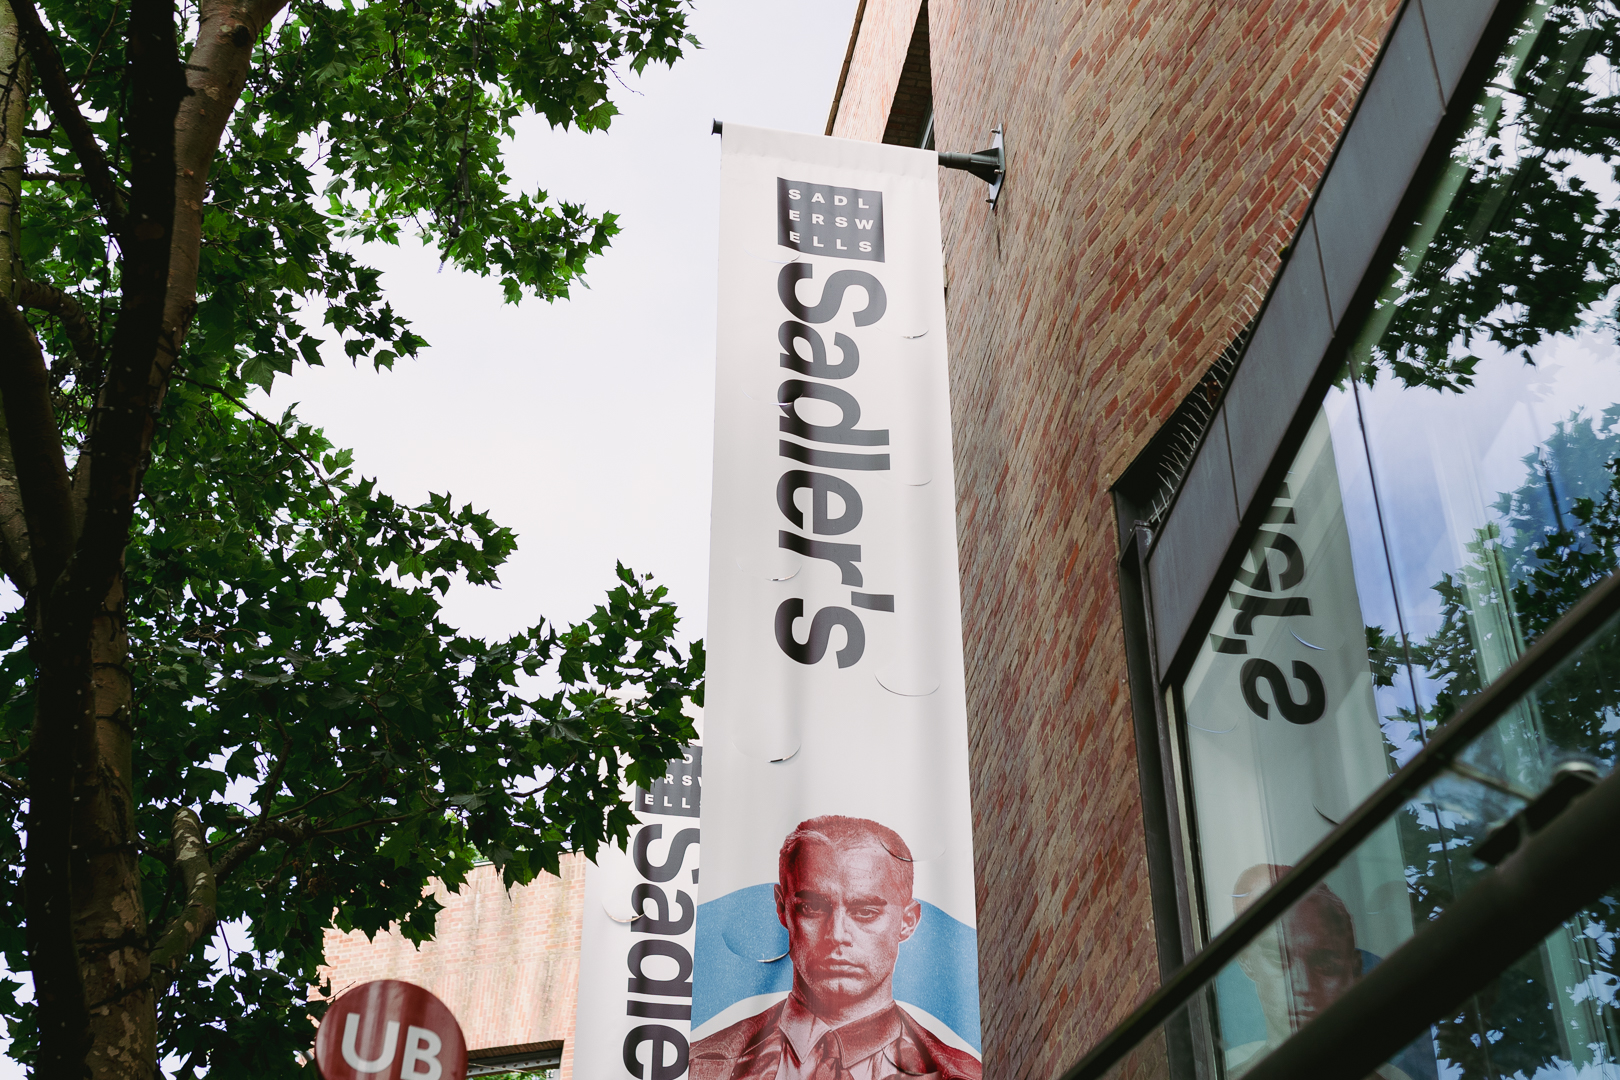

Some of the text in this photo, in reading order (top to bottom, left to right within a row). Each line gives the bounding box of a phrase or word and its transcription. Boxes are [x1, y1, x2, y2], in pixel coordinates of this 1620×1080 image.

[788, 188, 870, 209] SADL
[789, 209, 874, 230] ERSW
[789, 230, 872, 252] ELLS
[774, 262, 895, 669] Sadler's
[644, 793, 702, 809] ELL
[341, 1013, 443, 1080] UB
